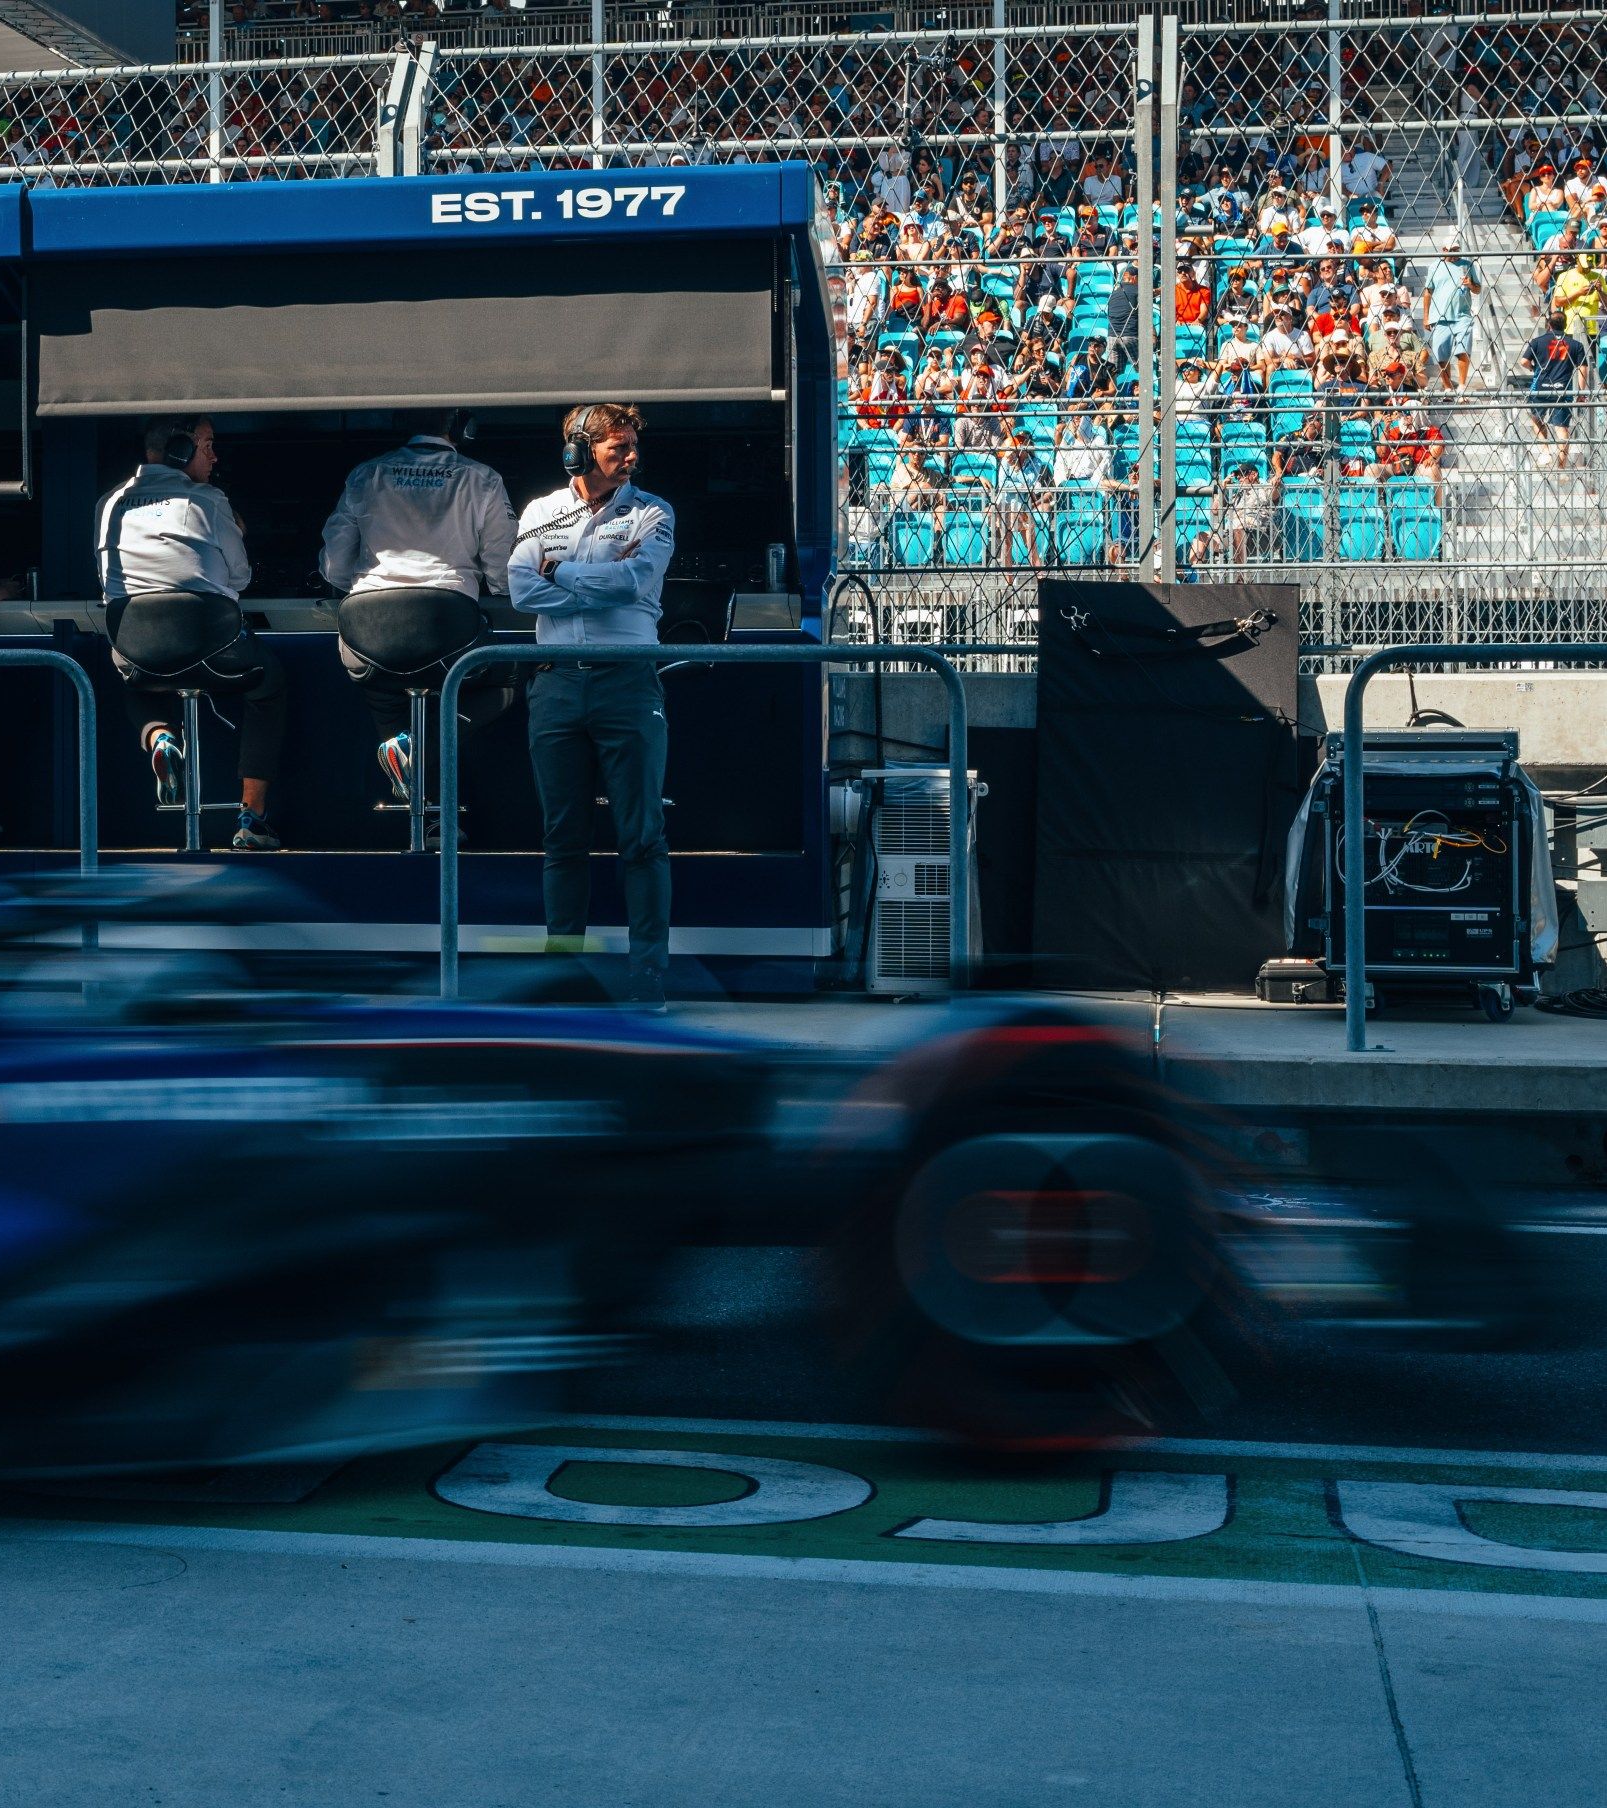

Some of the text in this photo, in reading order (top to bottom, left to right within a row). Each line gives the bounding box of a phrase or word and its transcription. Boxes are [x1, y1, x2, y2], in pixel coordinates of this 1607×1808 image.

[431, 185, 687, 224] EST. 1977
[392, 467, 453, 478] WILLIAMS
[396, 476, 445, 488] RACING
[118, 497, 171, 506] WILLIAMS
[599, 533, 630, 541] DURACELL
